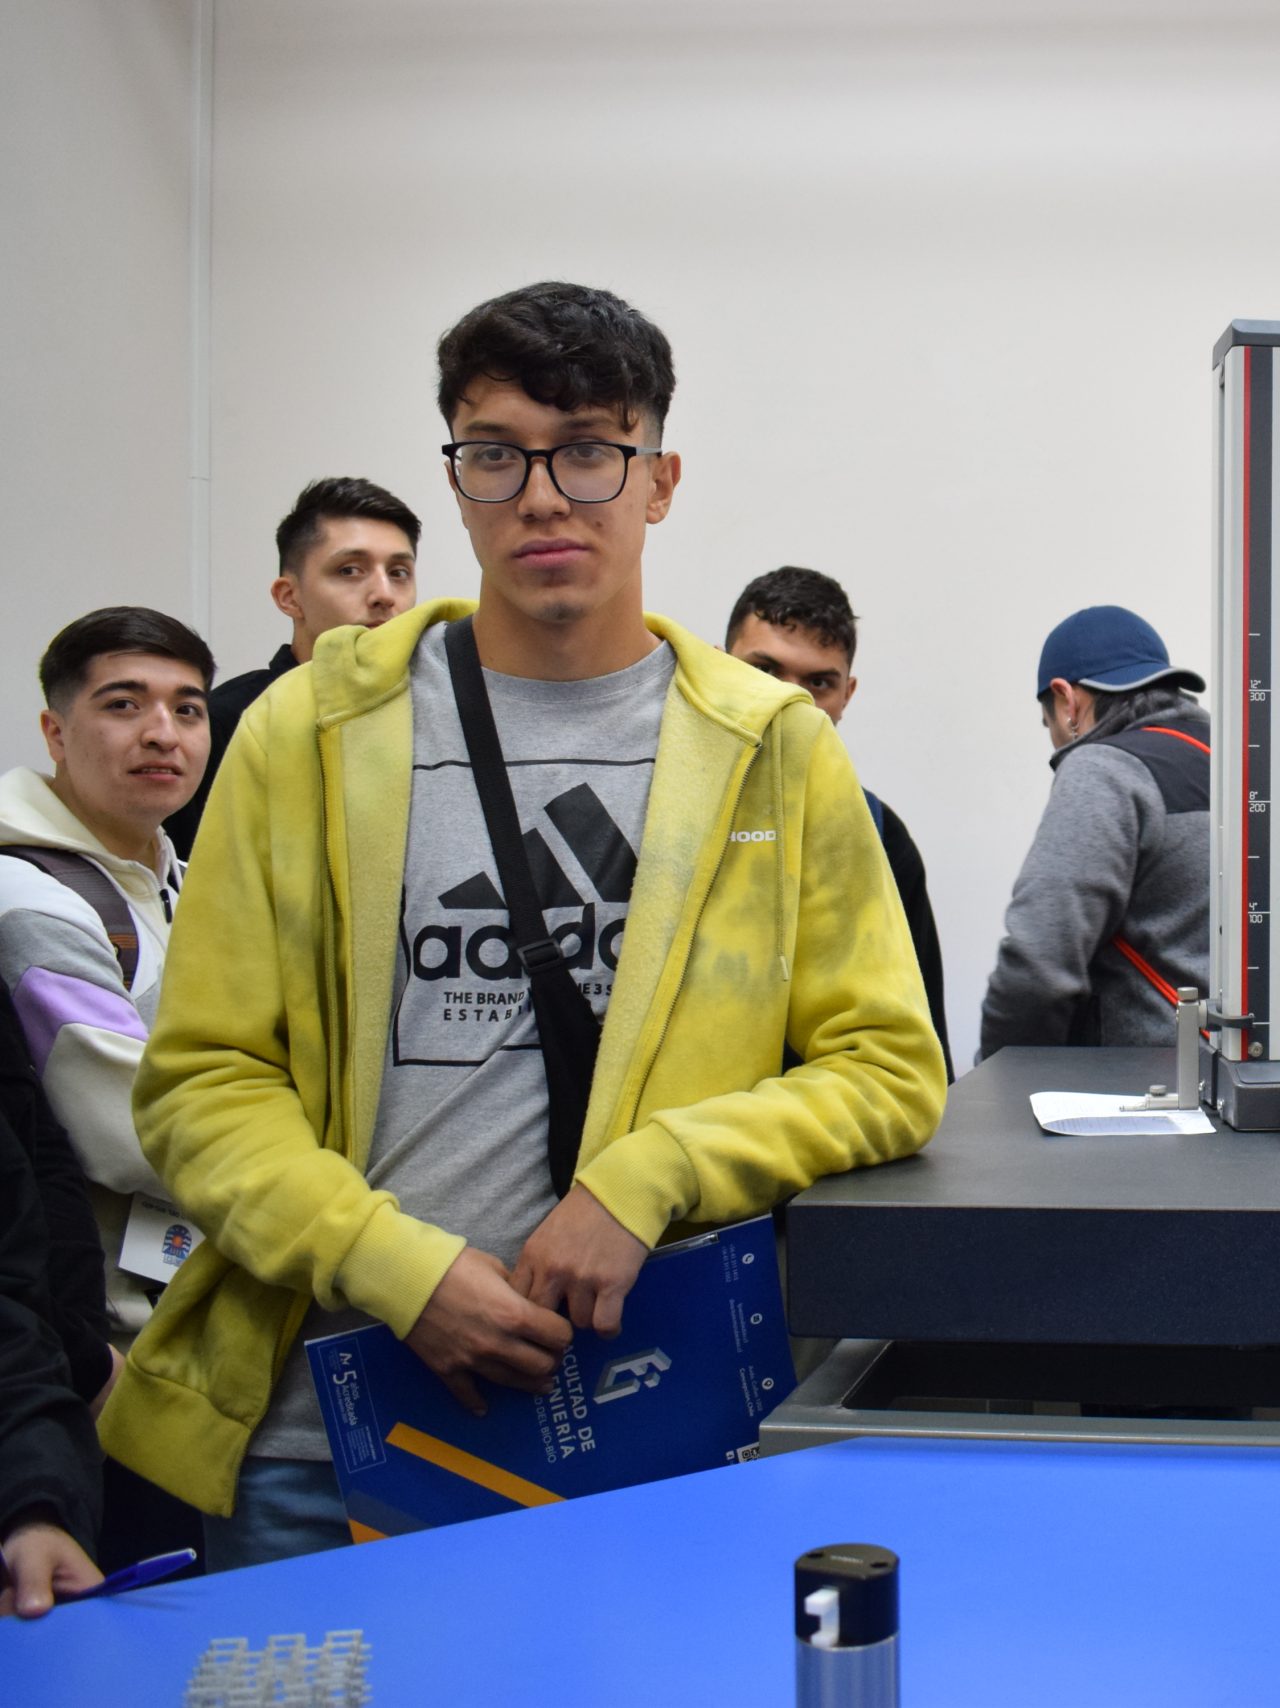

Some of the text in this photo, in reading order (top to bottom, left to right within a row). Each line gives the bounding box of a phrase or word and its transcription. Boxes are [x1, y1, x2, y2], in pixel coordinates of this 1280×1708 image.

[1249, 692, 1266, 701] 300
[1249, 803, 1266, 812] 200
[1249, 914, 1263, 924] 100
[594, 983, 603, 996] 3
[444, 991, 525, 1006] THE BRAND
[333, 1370, 358, 1385] 5
[563, 1345, 596, 1453] ACULTAD DE
[549, 1375, 577, 1459] NIERÍA
